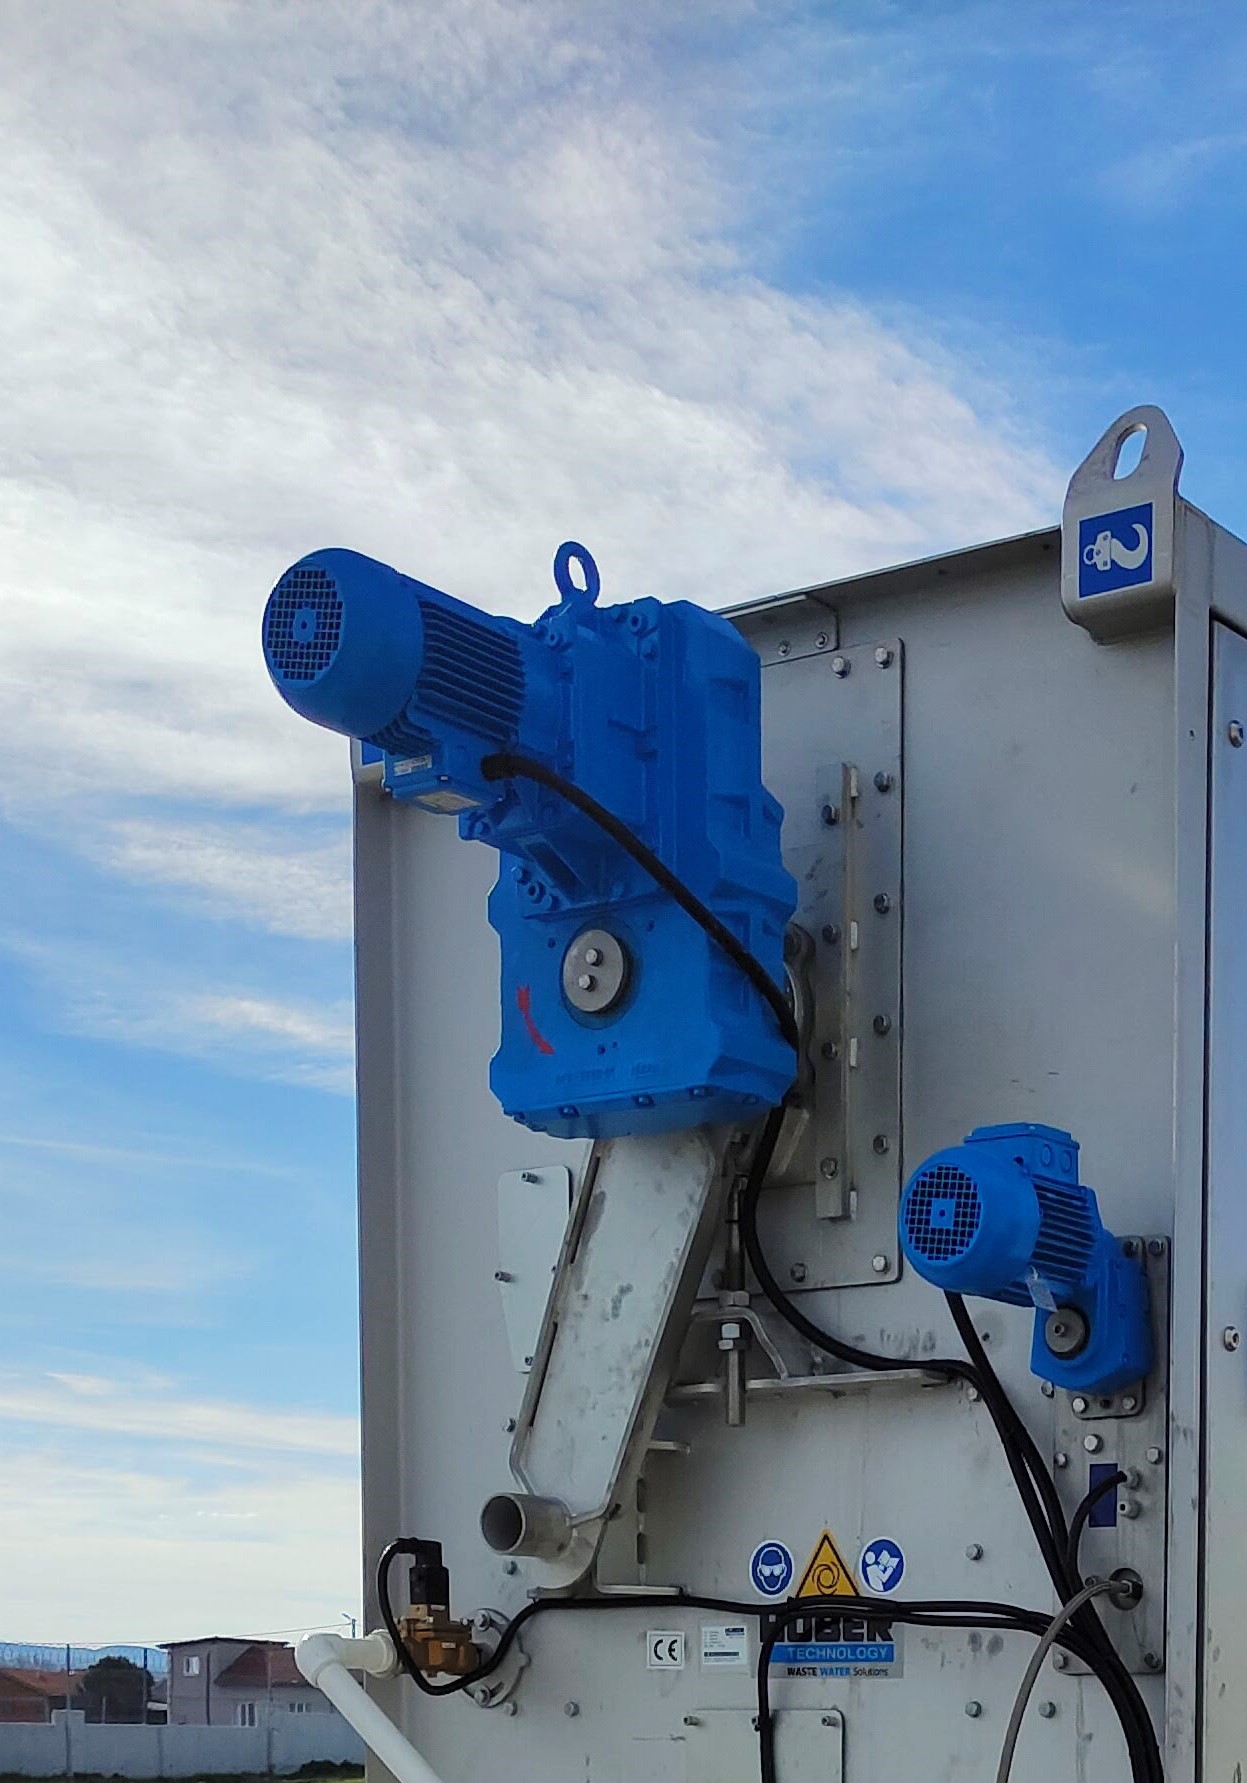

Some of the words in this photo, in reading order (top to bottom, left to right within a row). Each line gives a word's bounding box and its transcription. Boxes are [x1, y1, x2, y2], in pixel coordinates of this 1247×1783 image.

[653, 1639, 678, 1661] CE
[788, 1647, 888, 1660] TECHNOLOGY
[787, 1667, 817, 1676] WASTE
[820, 1667, 851, 1676] WATER
[853, 1667, 888, 1676] Solutions
